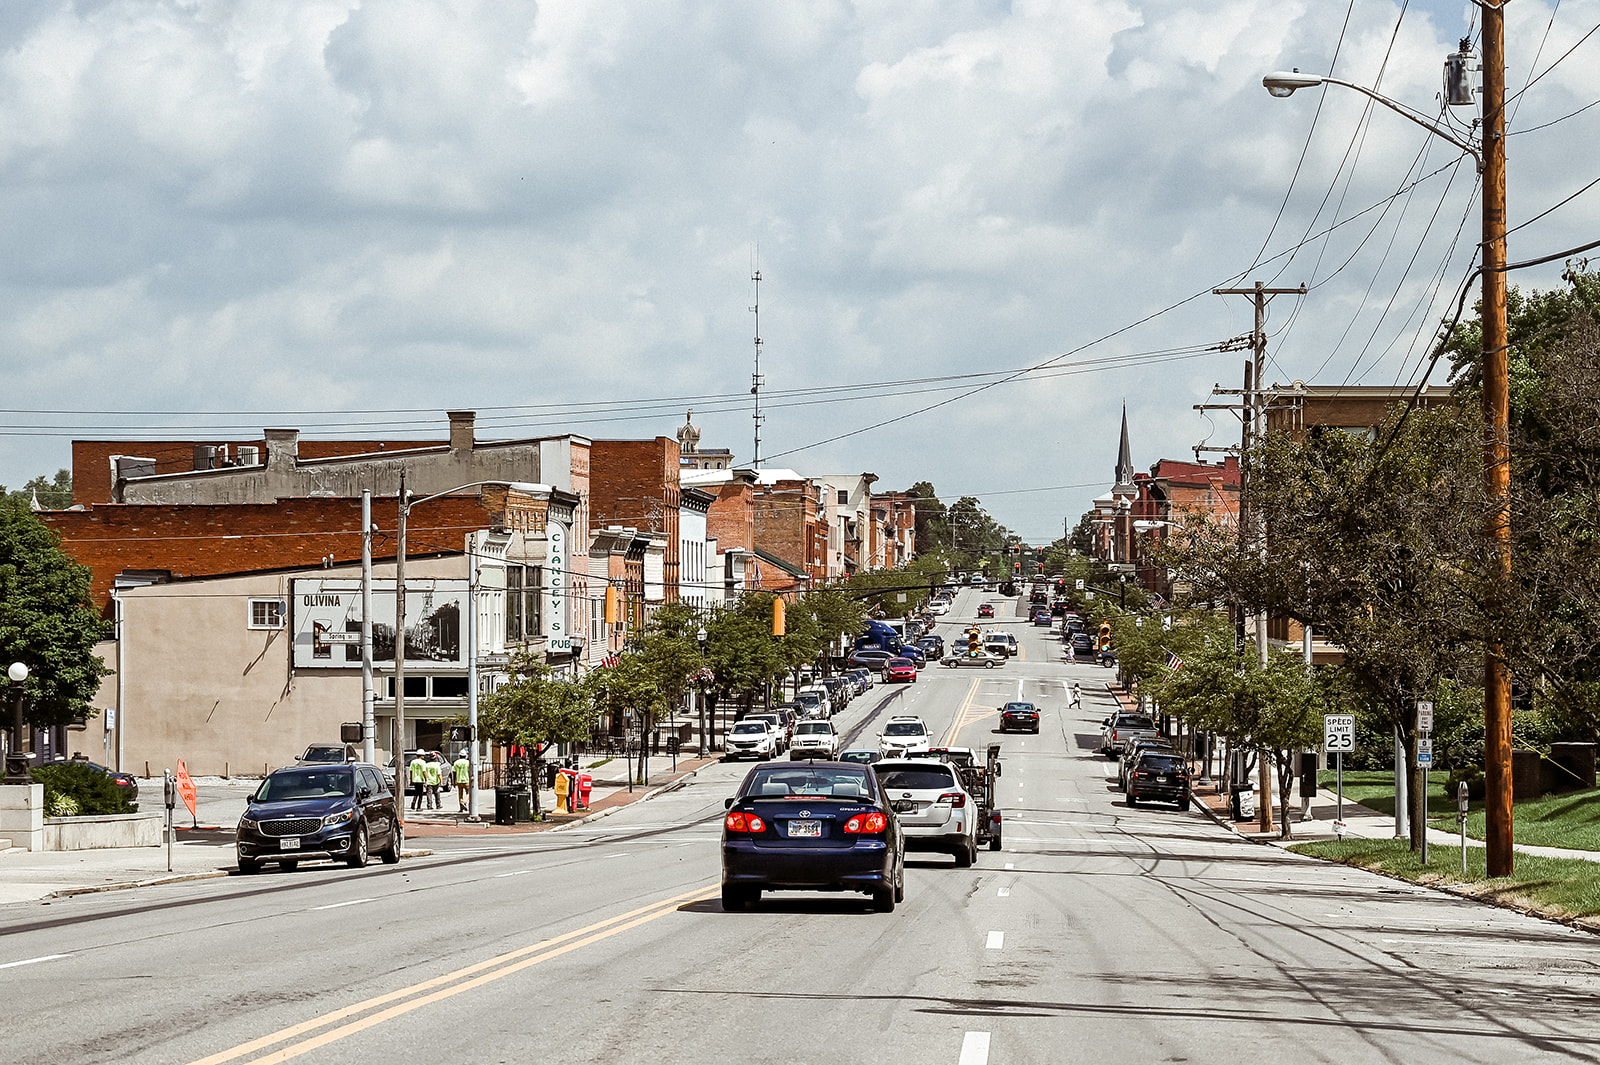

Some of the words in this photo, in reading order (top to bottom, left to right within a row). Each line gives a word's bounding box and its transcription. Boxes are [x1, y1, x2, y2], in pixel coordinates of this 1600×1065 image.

[304, 595, 341, 607] OLIVINA
[551, 639, 571, 649] PUB
[1327, 734, 1352, 748] 25
